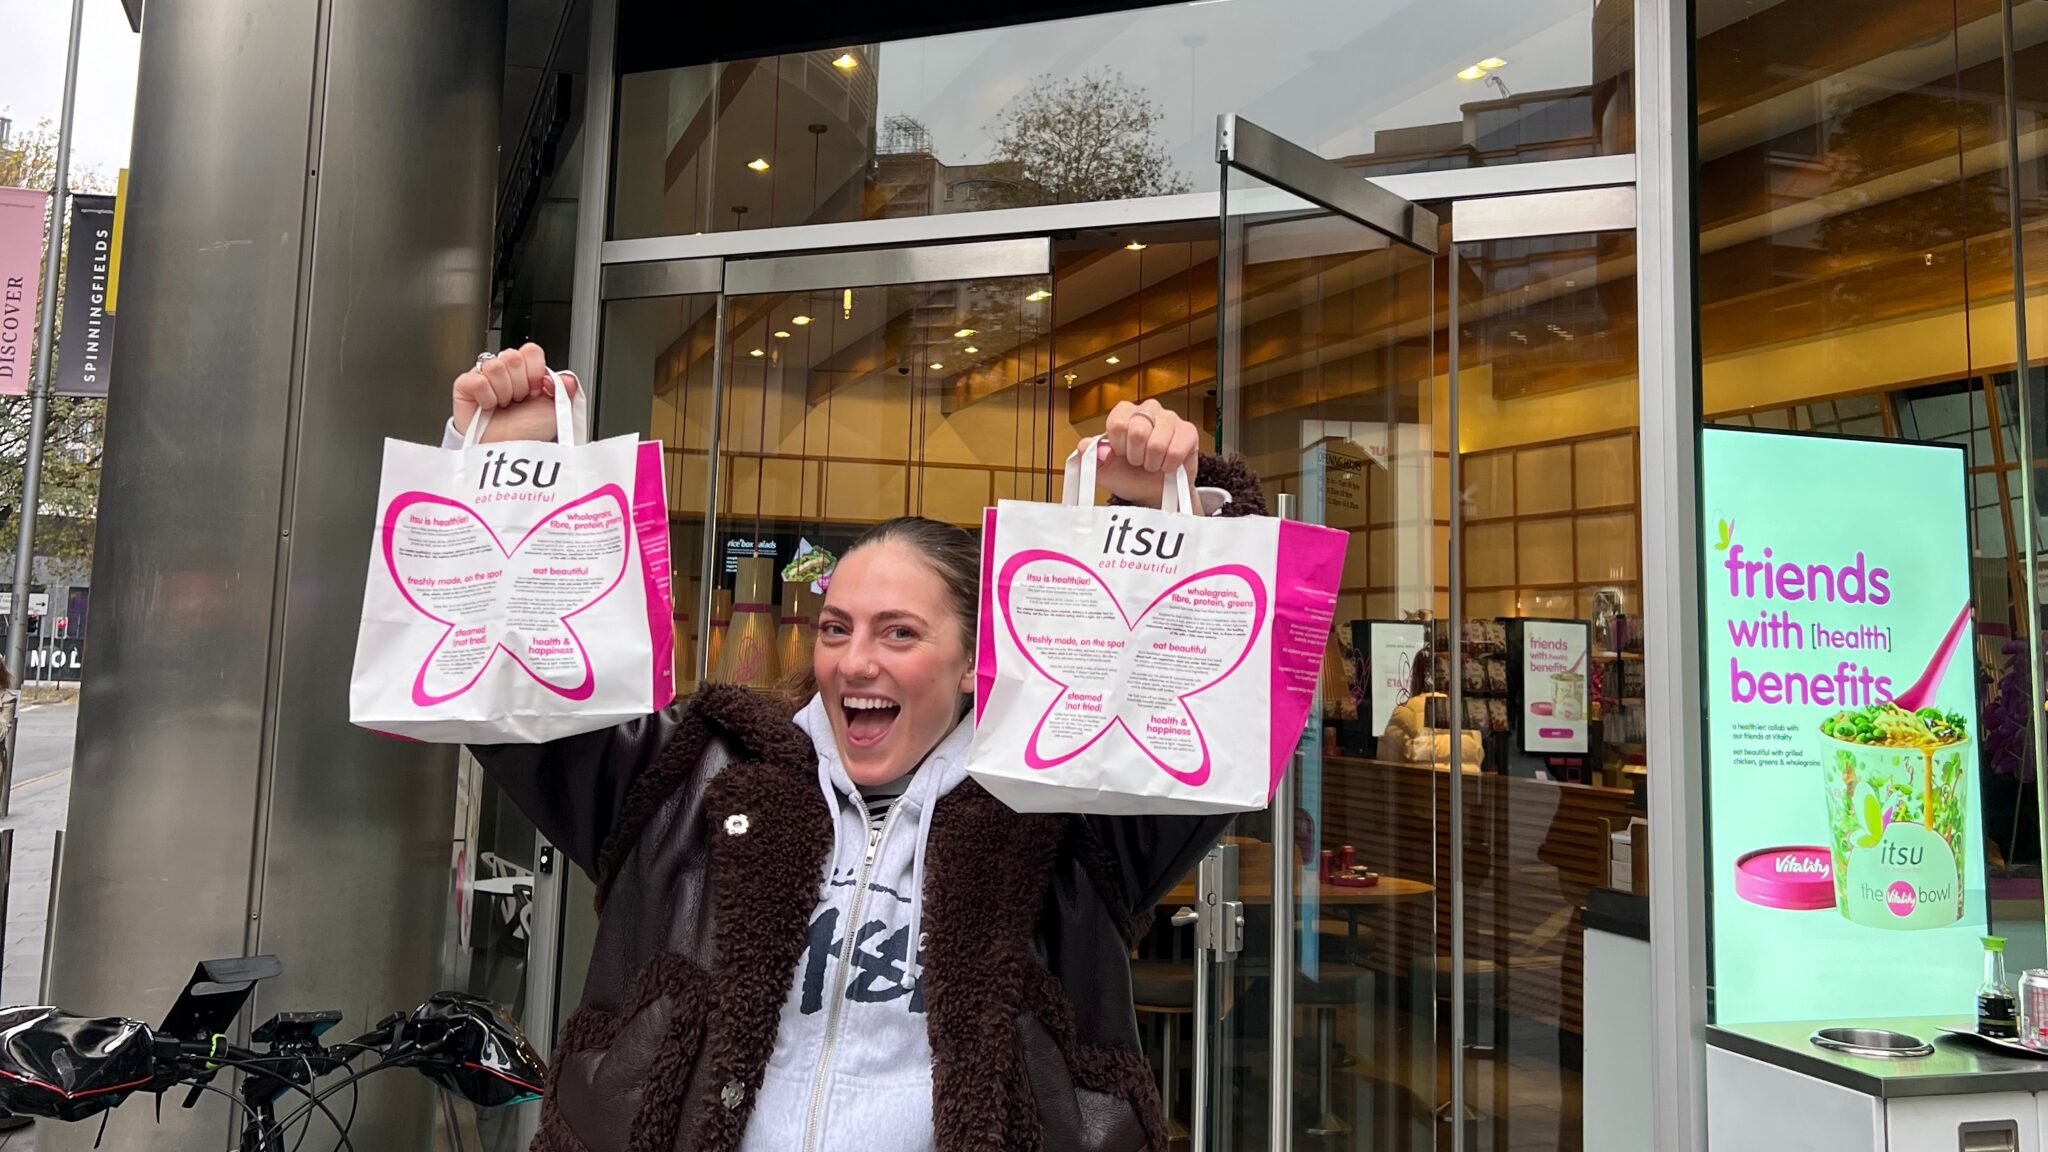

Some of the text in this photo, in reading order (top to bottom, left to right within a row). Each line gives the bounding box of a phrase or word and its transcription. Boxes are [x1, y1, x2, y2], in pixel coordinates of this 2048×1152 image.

[84, 229, 108, 382] SPINNINGFIELDS
[0, 276, 24, 379] DISCOVER
[479, 450, 561, 489] itsu
[475, 492, 555, 503] eat beautiful
[410, 515, 423, 524] itsu
[425, 517, 431, 525] is
[1103, 514, 1184, 559] itsu
[550, 567, 588, 575] beautiful
[1099, 559, 1178, 574] eat beautiful
[408, 575, 435, 587] freshly
[464, 575, 474, 583] on
[474, 572, 485, 581] the
[487, 570, 503, 582] spot
[1027, 574, 1041, 582] itsu
[1724, 544, 1891, 605] friends
[1188, 588, 1239, 599] wholegrains,
[1172, 594, 1253, 608] fibre, protein, greens
[455, 626, 486, 637] steamed
[1728, 610, 1892, 652] with [health]
[533, 637, 570, 646] health &
[1027, 633, 1052, 646] freshly
[1054, 637, 1079, 646] made,
[1093, 636, 1105, 646] the
[1107, 638, 1125, 648] spot
[1530, 636, 1568, 651] friends
[528, 646, 574, 655] happiness
[1153, 642, 1207, 654] eat beautiful
[1530, 651, 1548, 660] with
[1530, 661, 1567, 672] benefits
[1730, 657, 1893, 706] benefits
[1067, 693, 1103, 702] steamed
[1151, 715, 1188, 726] health &
[1146, 724, 1191, 736] happiness
[1768, 723, 1785, 731] collab
[1772, 733, 1792, 742] Vitality
[1785, 750, 1803, 758] grilled
[1733, 758, 1757, 766] chicken,
[1786, 759, 1821, 768] wholegrains
[1881, 839, 1924, 866] itsu
[1775, 853, 1830, 879] Vitality
[1861, 882, 1951, 907] the Vitality bowl
